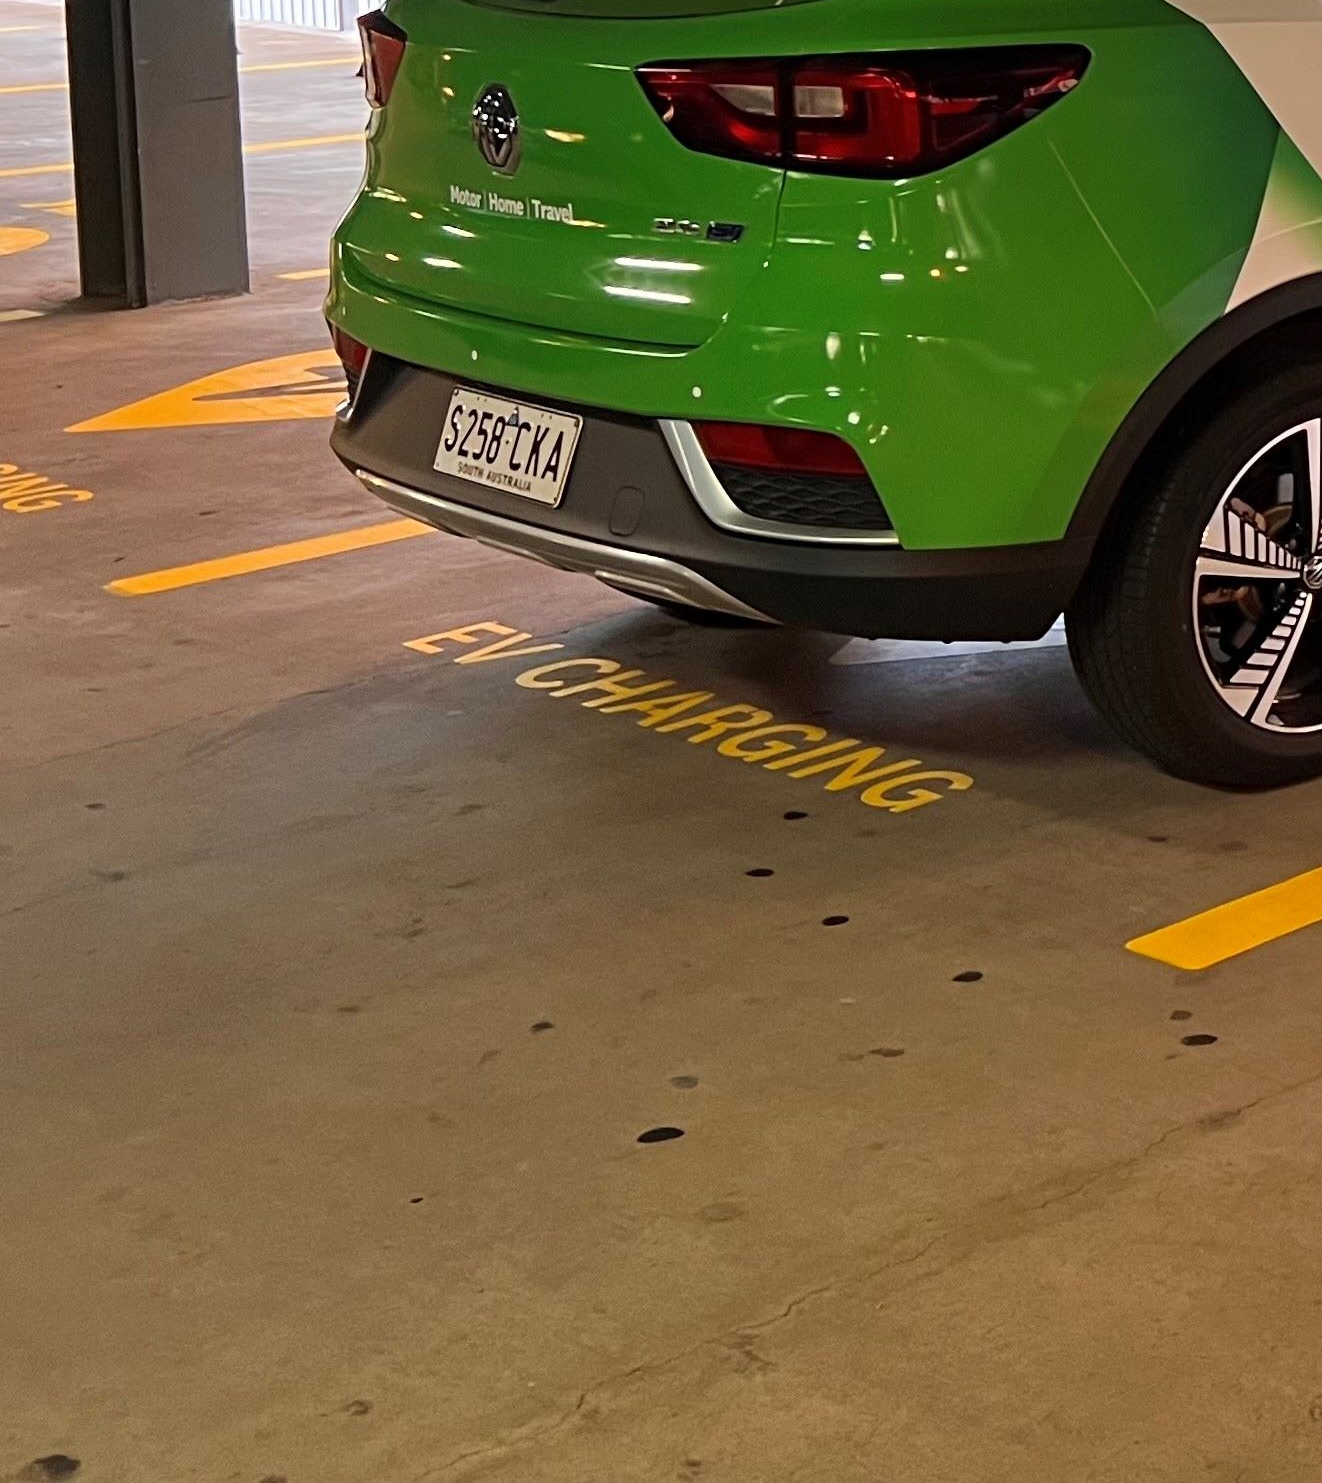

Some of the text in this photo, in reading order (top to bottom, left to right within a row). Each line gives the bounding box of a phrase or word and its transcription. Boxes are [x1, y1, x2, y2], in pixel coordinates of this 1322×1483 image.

[450, 185, 573, 223] Motor Home Travel
[444, 404, 564, 483] S258 CKA
[457, 461, 532, 492] SOUTH AUSTRALIA
[402, 620, 975, 813] EV CHARGING
